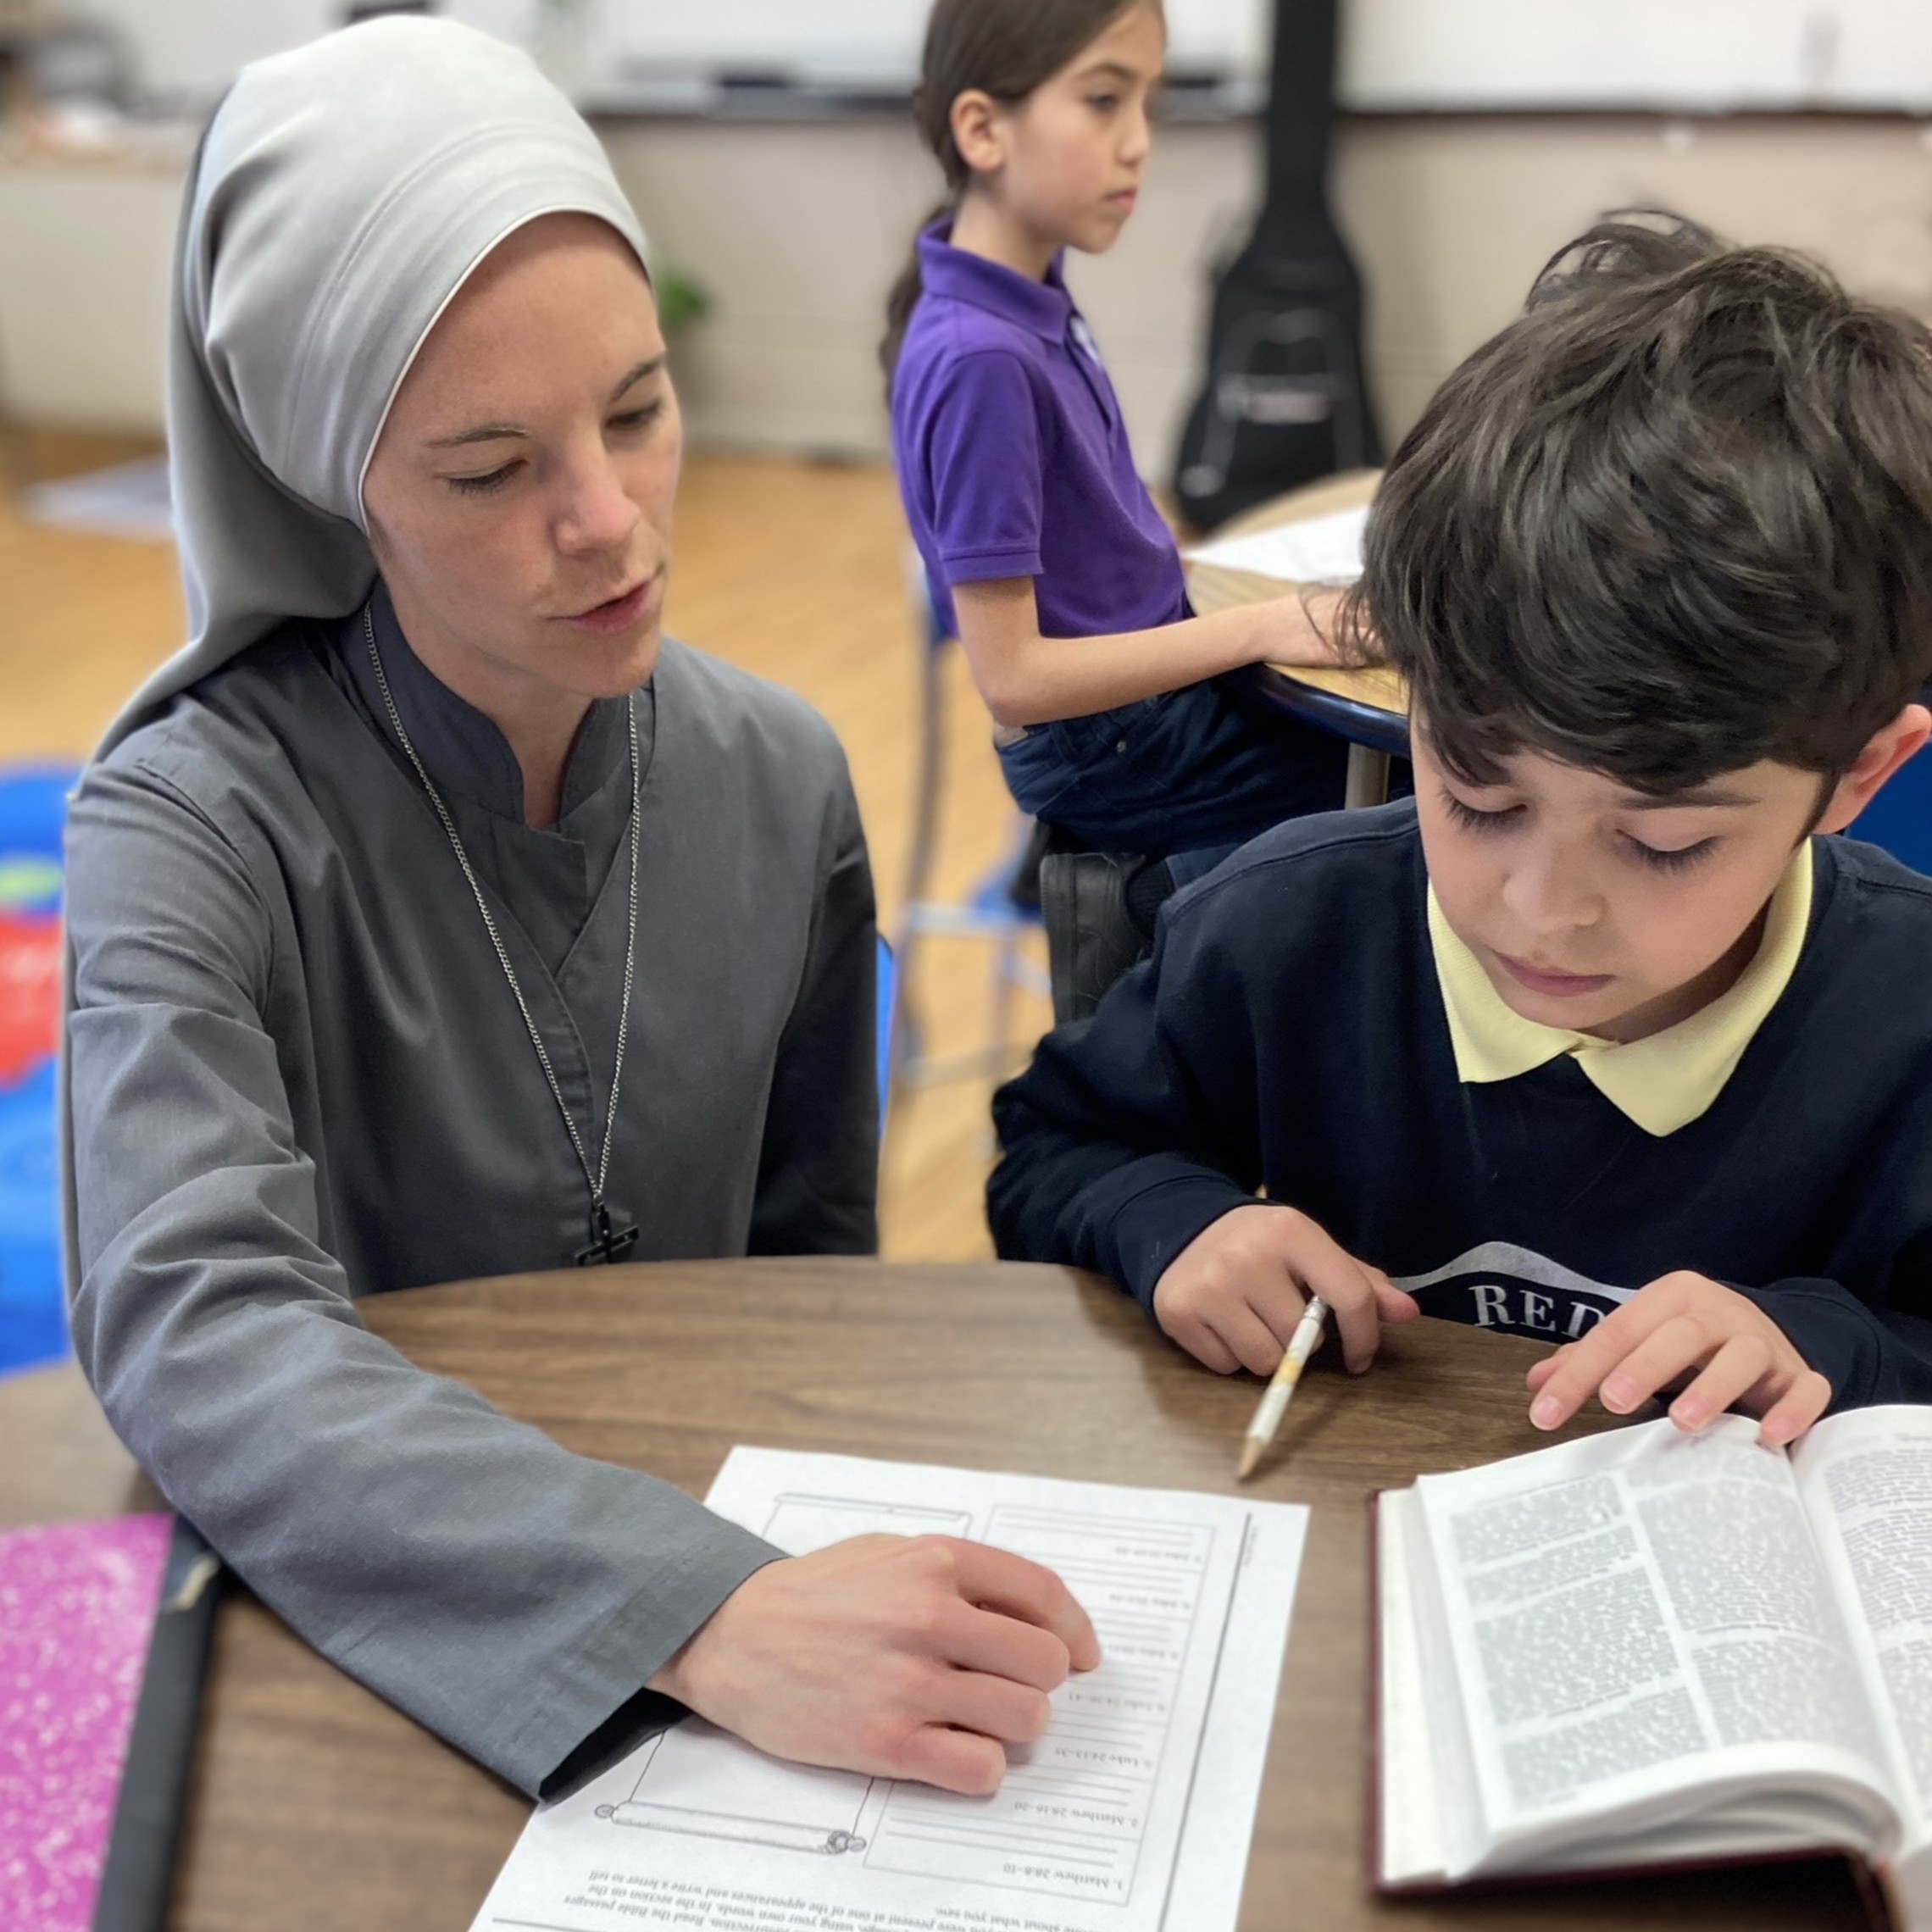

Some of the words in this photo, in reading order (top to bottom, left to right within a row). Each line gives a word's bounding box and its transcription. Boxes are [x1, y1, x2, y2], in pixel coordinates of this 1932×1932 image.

[1108, 1752, 1138, 1767] Luke
[1070, 1807, 1124, 1826] Matthew
[588, 1869, 608, 1882] tell
[612, 1873, 624, 1883] to
[625, 1874, 658, 1889] letter
[1053, 1869, 1109, 1888] Matthew
[587, 1884, 608, 1896] the
[610, 1887, 626, 1897] on
[669, 1881, 702, 1895] write
[705, 1887, 728, 1899] and
[563, 1893, 615, 1910] passages
[629, 1890, 673, 1905] section
[676, 1896, 695, 1909] the
[616, 1902, 647, 1917] Bible
[697, 1900, 711, 1912] In
[808, 1903, 828, 1913] the
[830, 1906, 844, 1917] of
[651, 1907, 671, 1920] the
[673, 1911, 704, 1926] Read
[758, 1909, 785, 1921] own
[847, 1908, 870, 1918] one
[871, 1912, 885, 1921] at
